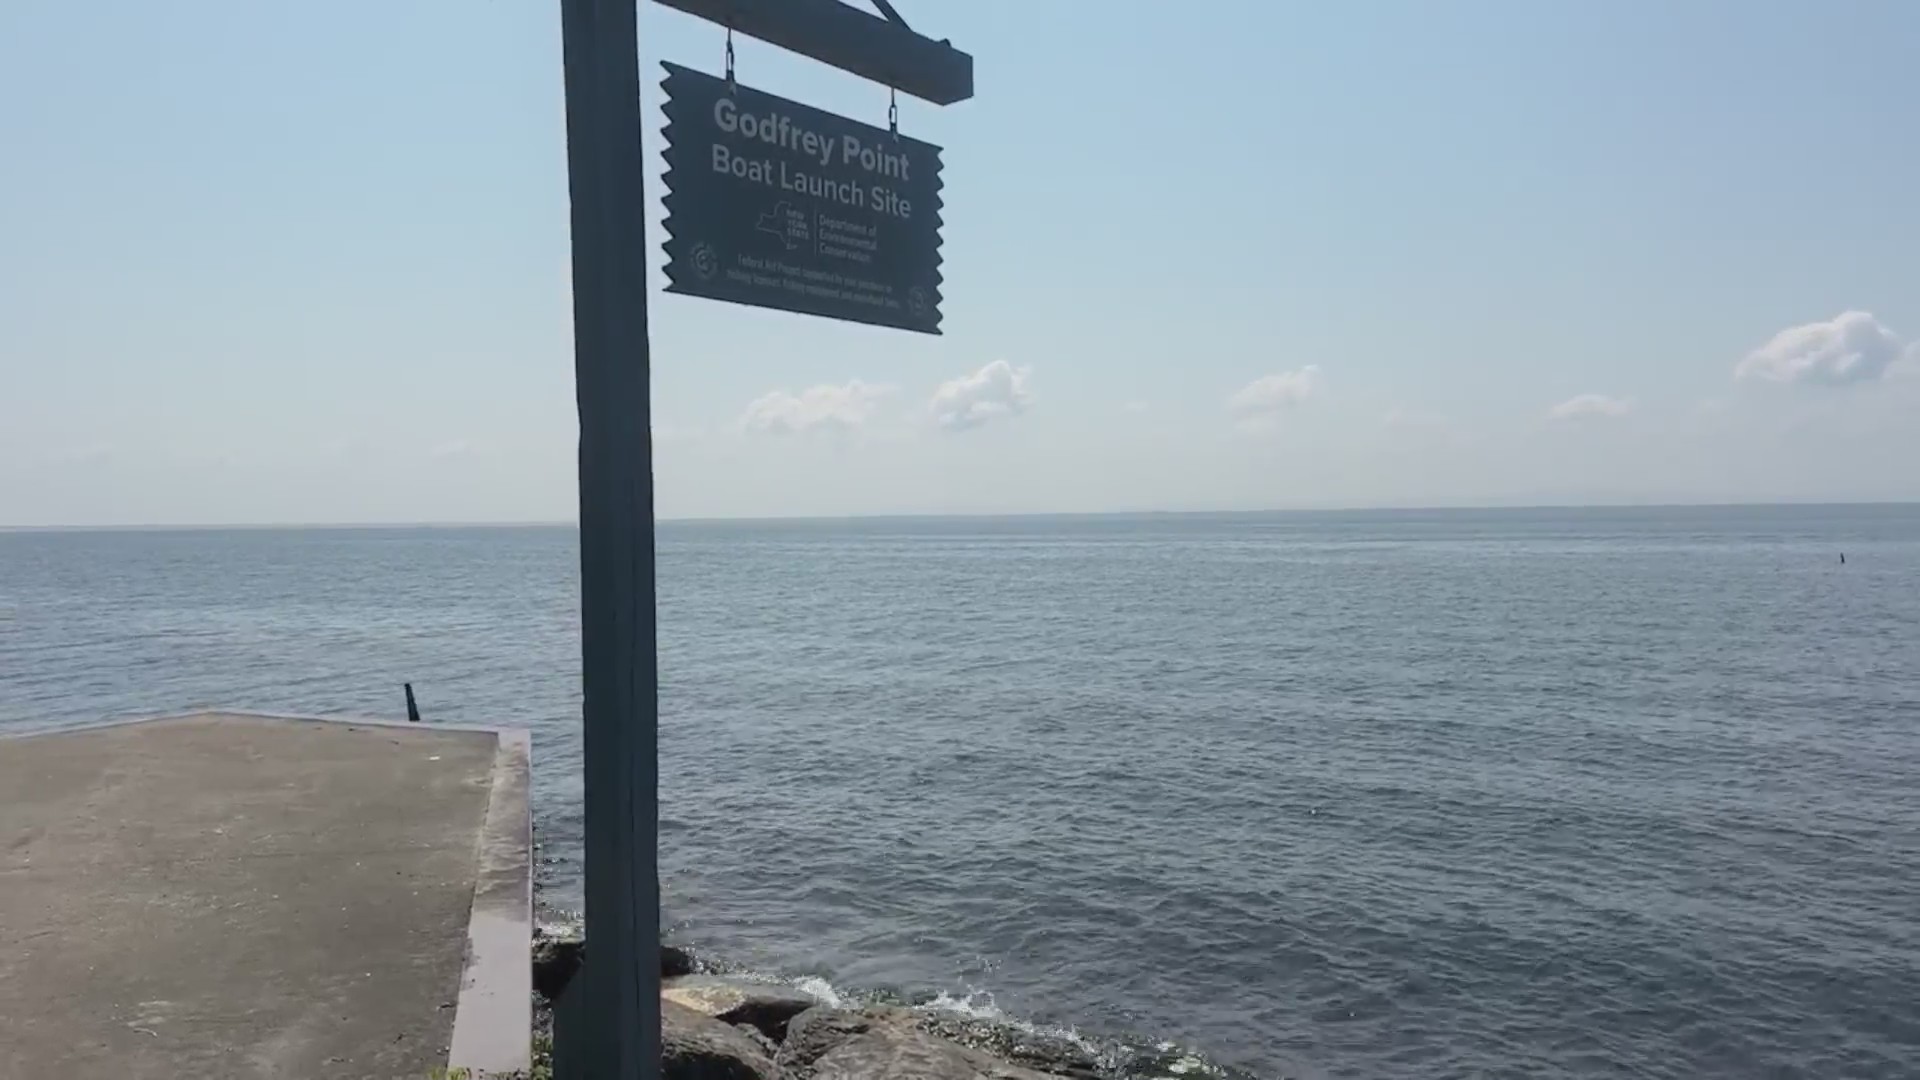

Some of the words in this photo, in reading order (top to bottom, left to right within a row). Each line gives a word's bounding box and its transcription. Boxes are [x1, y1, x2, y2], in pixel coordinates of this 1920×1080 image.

[714, 98, 834, 166] Godfrey
[843, 134, 910, 180] Point
[712, 143, 773, 185] Boat
[780, 161, 864, 206] Launch
[871, 185, 912, 218] Site
[819, 214, 867, 235] Department
[868, 226, 877, 237] of
